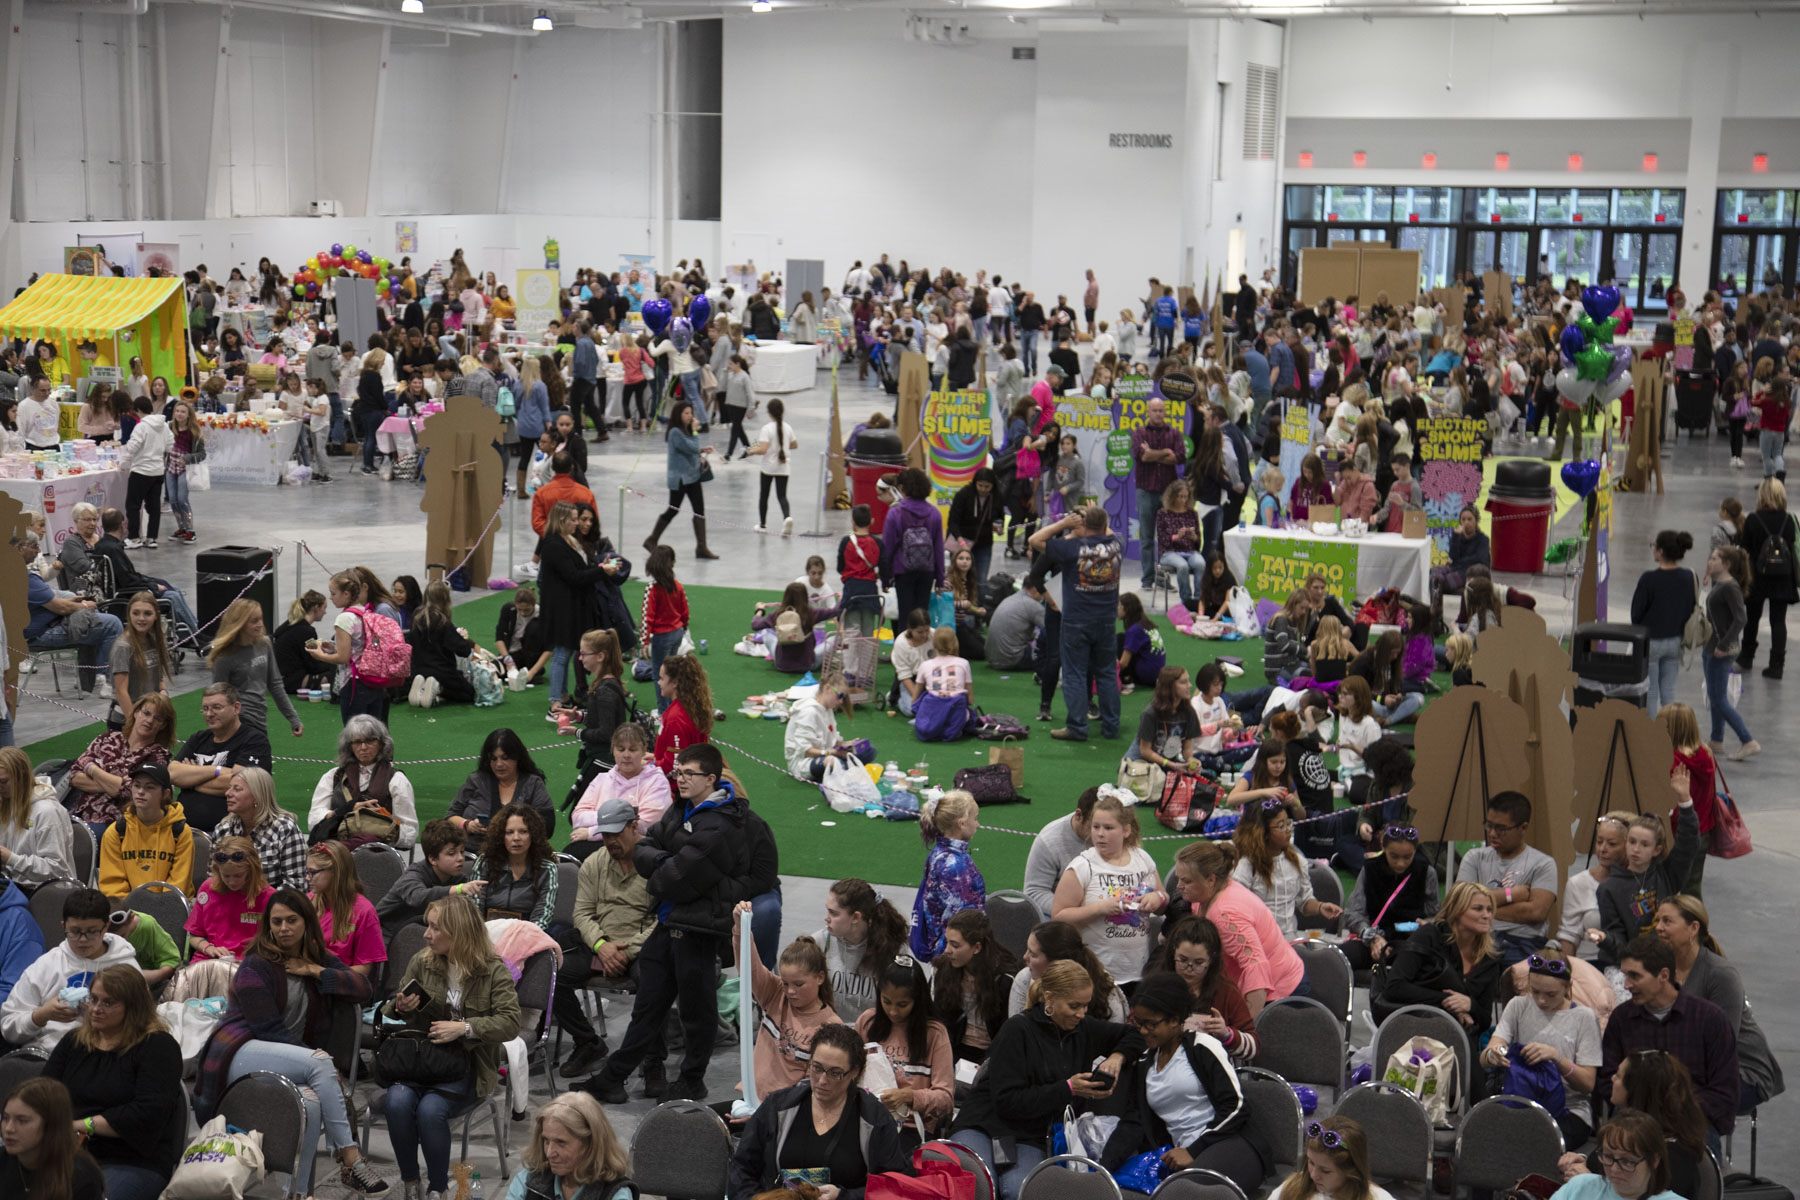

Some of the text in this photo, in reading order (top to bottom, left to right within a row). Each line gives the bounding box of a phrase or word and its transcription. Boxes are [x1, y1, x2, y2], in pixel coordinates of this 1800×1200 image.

[1109, 133, 1171, 148] RESTROOMS
[1136, 379, 1154, 387] YOUR
[930, 391, 986, 404] BUTTER
[937, 403, 980, 415] SWIRL
[1119, 398, 1187, 417] TOEN
[923, 416, 992, 437] SLIME
[1054, 411, 1111, 431] SLIME
[1416, 418, 1488, 432] ELECTRIC
[1281, 423, 1310, 446] SLIME
[1428, 430, 1475, 444] SNOW
[1421, 443, 1482, 462] SLIME
[1261, 554, 1344, 582] TATTOO
[1257, 573, 1343, 599] STATN
[121, 849, 175, 864] INNESOT
[1098, 873, 1116, 887] I'VE
[1118, 874, 1134, 886] GOT
[1105, 926, 1137, 939] Besties
[831, 970, 877, 999] ONDON
[184, 1151, 227, 1164] BASH
